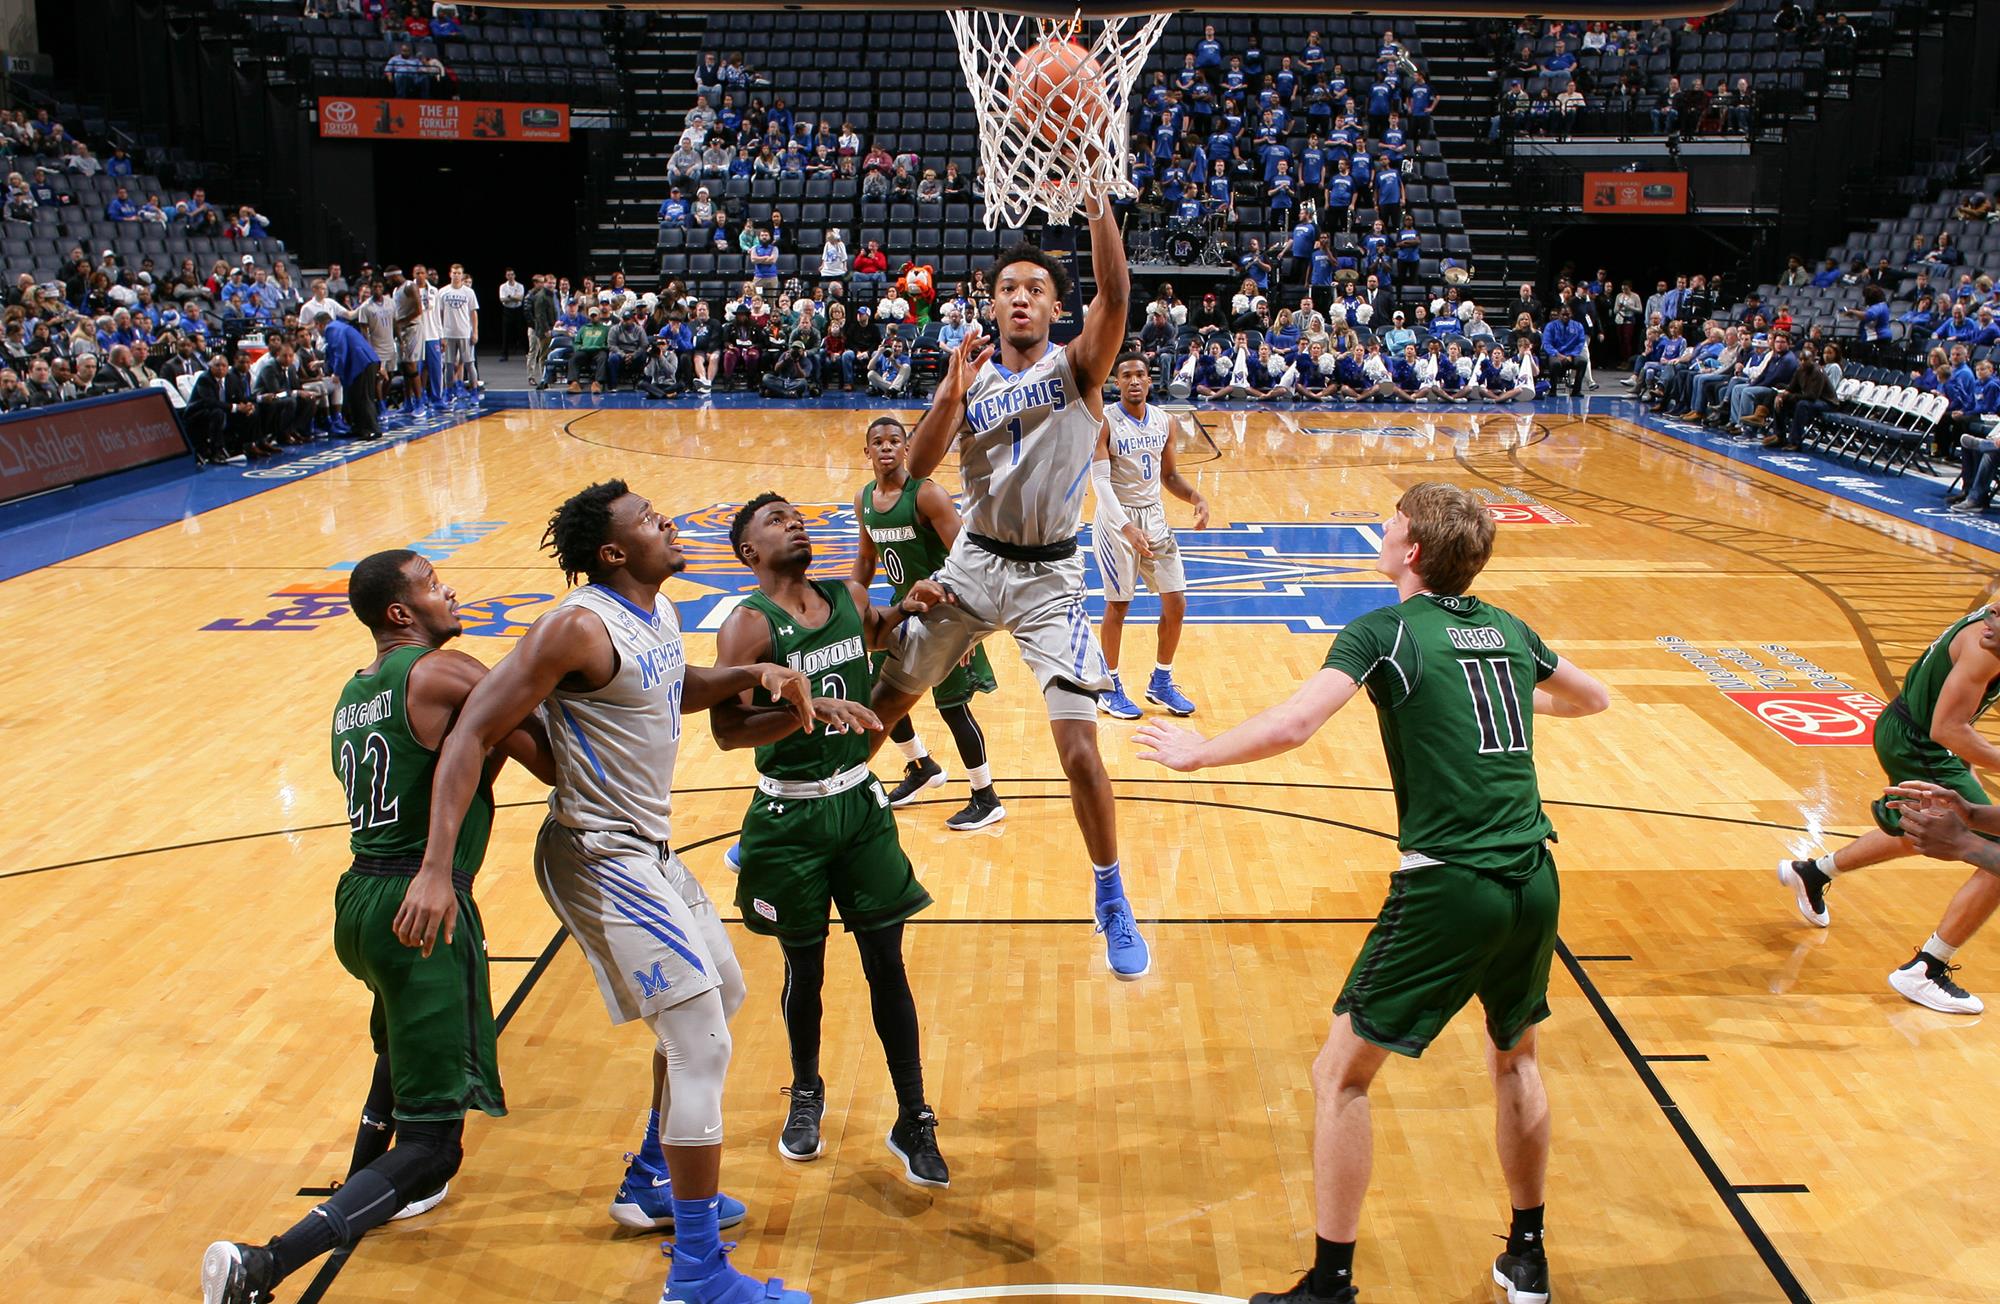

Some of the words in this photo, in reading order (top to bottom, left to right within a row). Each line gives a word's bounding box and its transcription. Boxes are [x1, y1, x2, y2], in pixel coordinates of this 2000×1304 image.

[323, 121, 359, 131] TOYOTA
[419, 104, 443, 117] THE
[446, 105, 459, 118] #1
[419, 117, 458, 129] FORKLIFT
[966, 378, 1067, 434] MEMPHIS
[18, 423, 88, 471] Ashley
[96, 427, 126, 452] this
[126, 426, 140, 446] is
[1006, 417, 1023, 474] 1
[1141, 453, 1152, 480] 3
[864, 524, 917, 543] LOYOLA
[884, 547, 904, 584] 0
[786, 635, 865, 676] LOYOLA
[1446, 627, 1506, 649] REED
[635, 638, 684, 691] MEMPH
[1655, 635, 1755, 691] Memphis
[1717, 647, 1798, 691] Toyota
[1759, 643, 1855, 691] Dealers
[335, 689, 393, 736] GREGORY
[1456, 657, 1528, 754] 11
[339, 731, 399, 832] 22
[633, 961, 672, 1000] M
